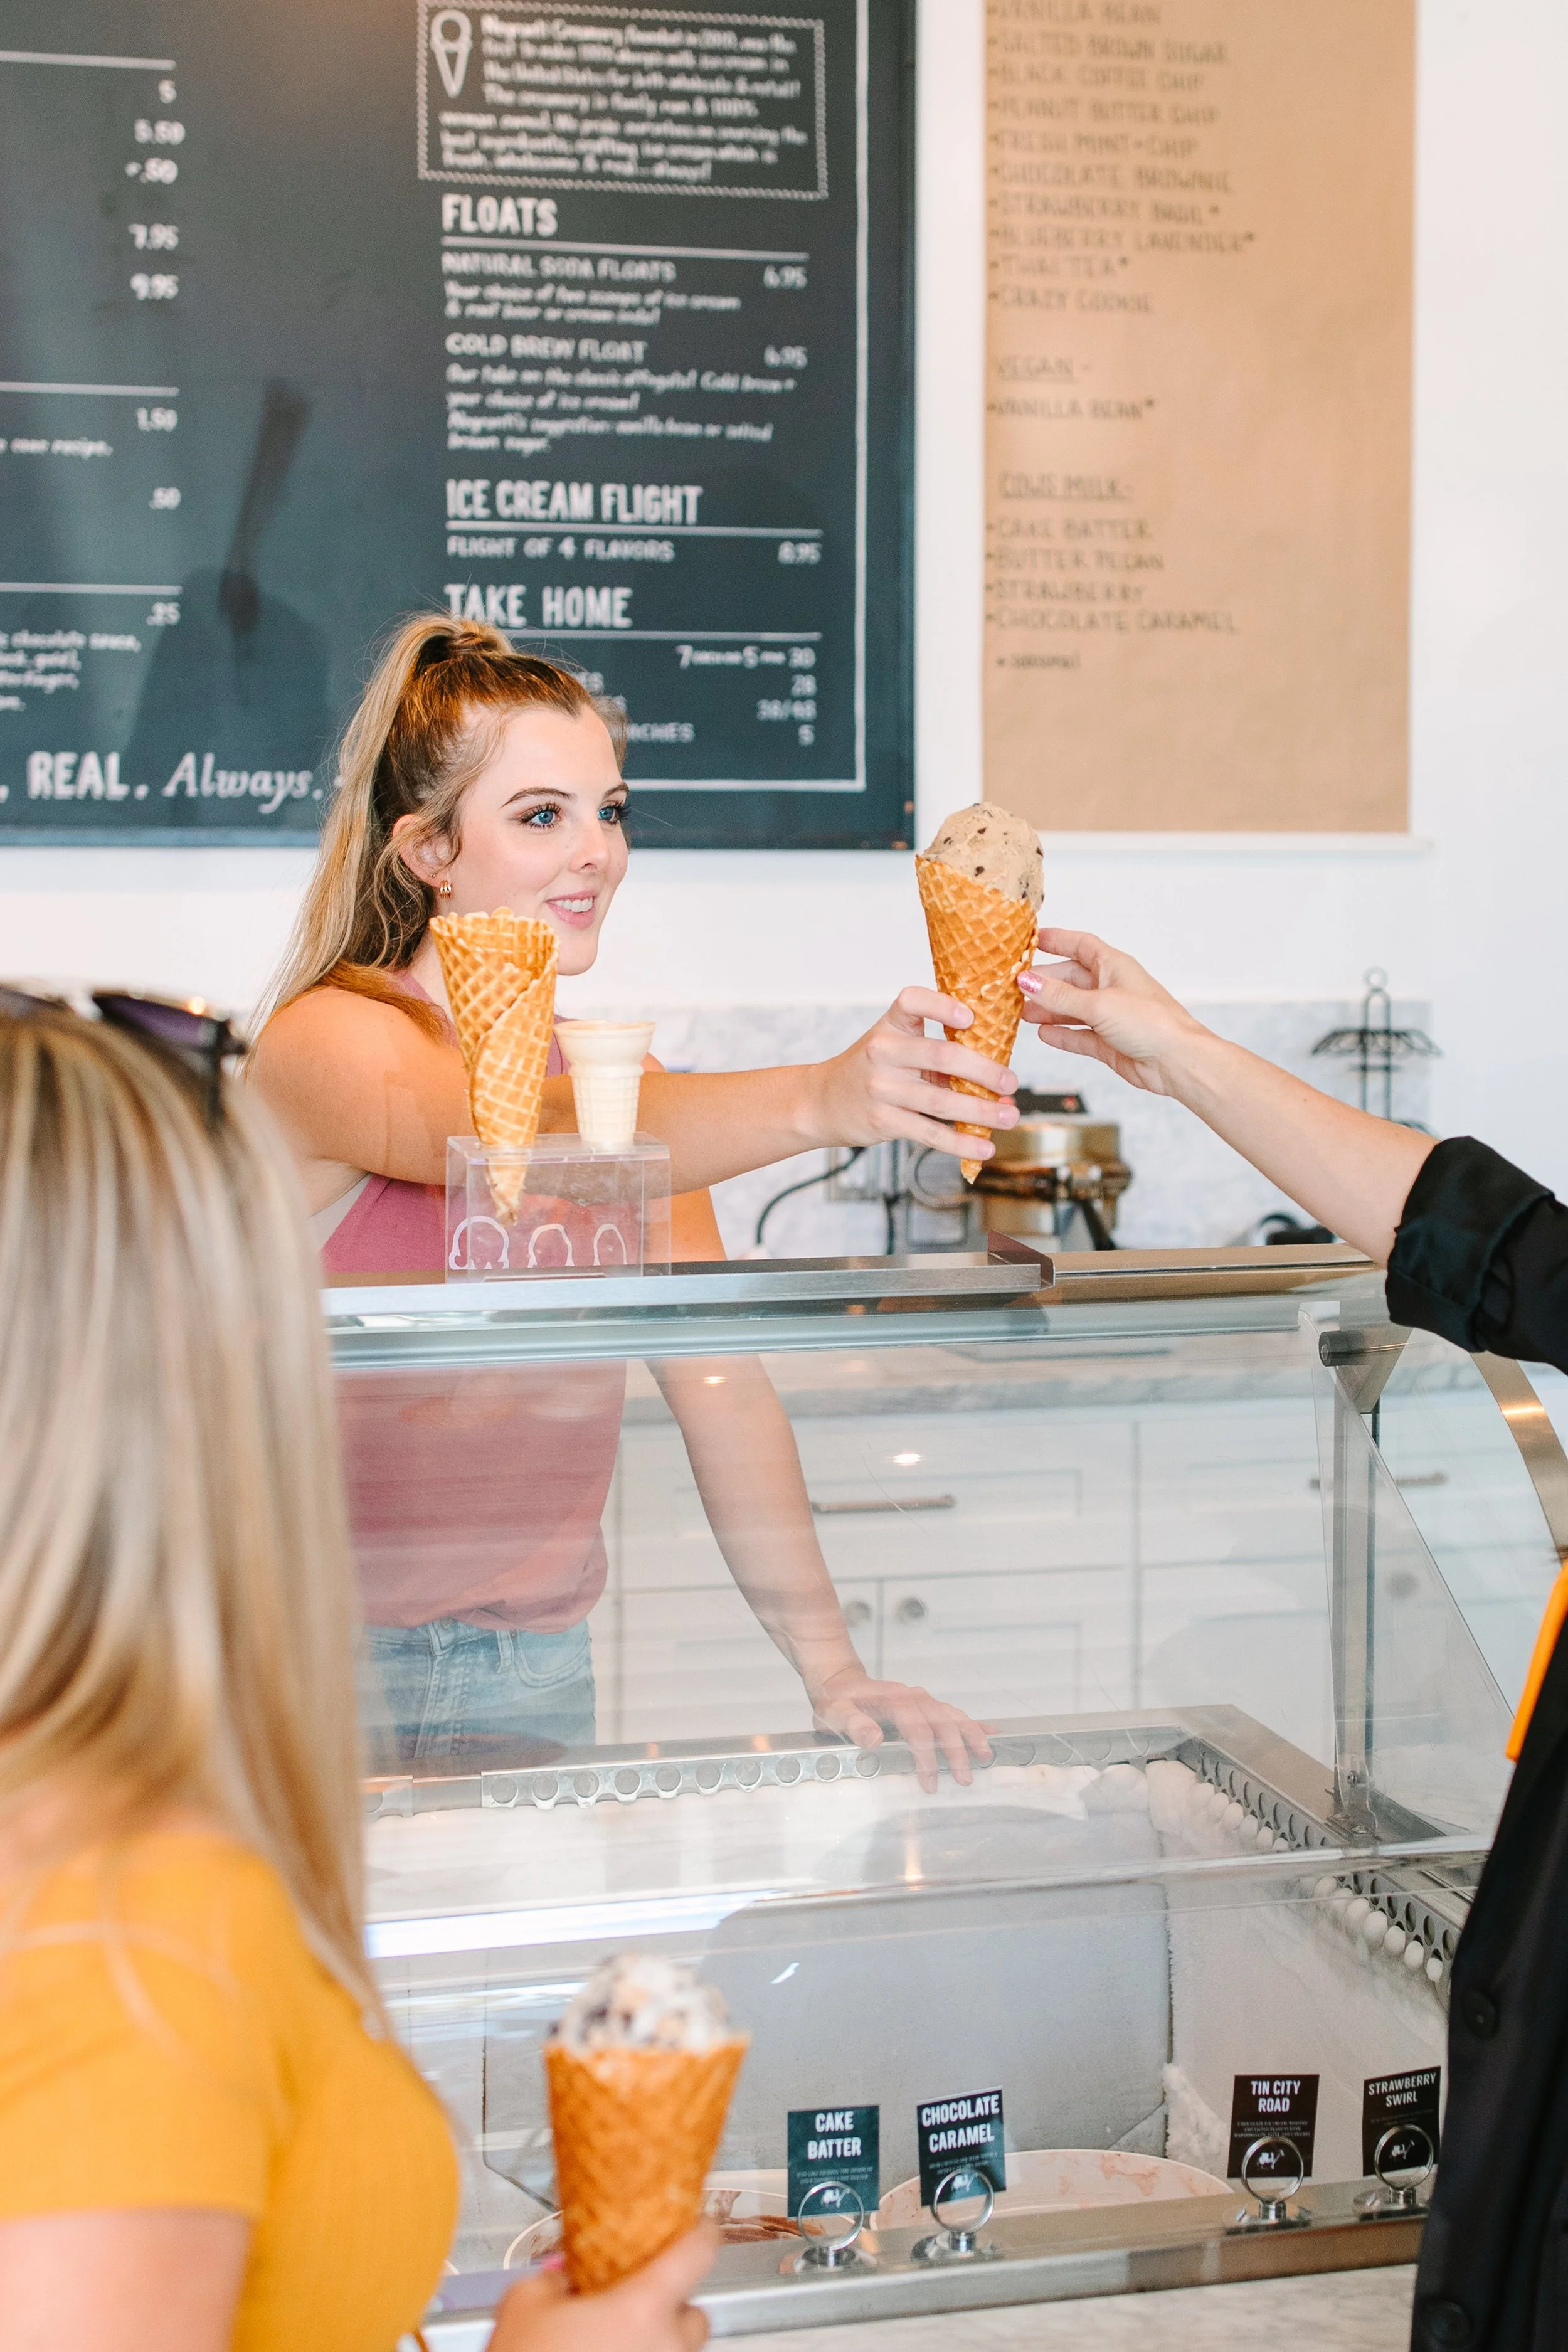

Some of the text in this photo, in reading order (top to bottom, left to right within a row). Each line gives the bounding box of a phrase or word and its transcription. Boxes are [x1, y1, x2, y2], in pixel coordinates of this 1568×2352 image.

[441, 193, 558, 236] FLOATS
[440, 252, 807, 290] NATURAL SODA FLOATS 6.95
[444, 332, 808, 371] COLD BREW FLOAT 6.95
[997, 396, 1085, 419] VANILLA
[445, 478, 703, 526] ICE CREAM FLIGHT
[1063, 517, 1152, 540] BATTER
[446, 535, 516, 558] FLIGHT
[522, 536, 553, 559] OF
[558, 536, 575, 561] 4
[583, 538, 675, 562] FLAVORS
[443, 583, 633, 628] TAKE HOME
[996, 607, 1241, 635] CHOCOLATE CARAMEL
[675, 644, 692, 669] 7
[26, 751, 149, 802] REAL.
[162, 751, 325, 814] Always.
[1251, 2080, 1301, 2096] TIN CITY
[1368, 2072, 1438, 2096] STRAWBERRY
[921, 2094, 1000, 2128] CHOCOLATE
[1258, 2097, 1290, 2113] ROAD
[1385, 2092, 1419, 2108] SWIRL
[815, 2111, 854, 2132] CAKE
[807, 2137, 862, 2160] BATTER
[928, 2122, 995, 2153] CARAMEL
